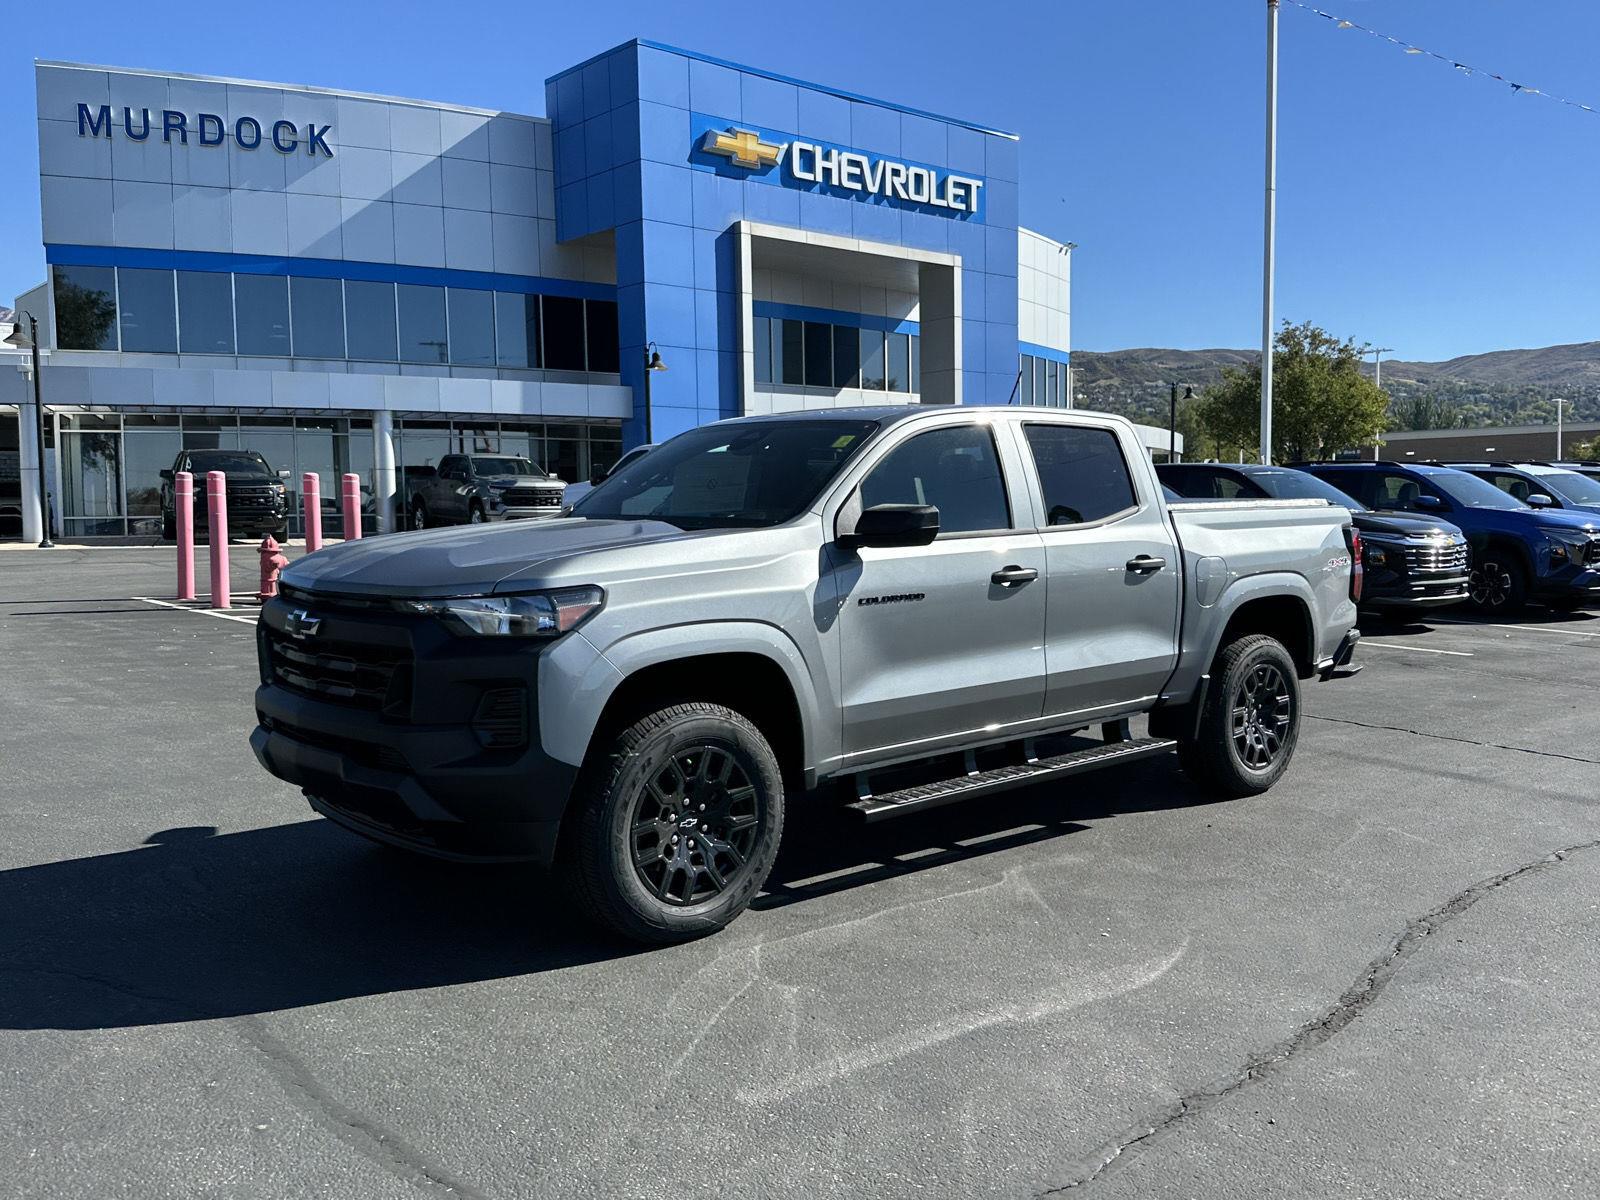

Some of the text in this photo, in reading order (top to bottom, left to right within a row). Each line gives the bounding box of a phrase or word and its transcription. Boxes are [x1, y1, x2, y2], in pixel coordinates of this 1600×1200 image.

[77, 102, 334, 158] MURDOCK
[791, 140, 983, 213] CHEVROLET
[857, 592, 926, 607] COLORADO
